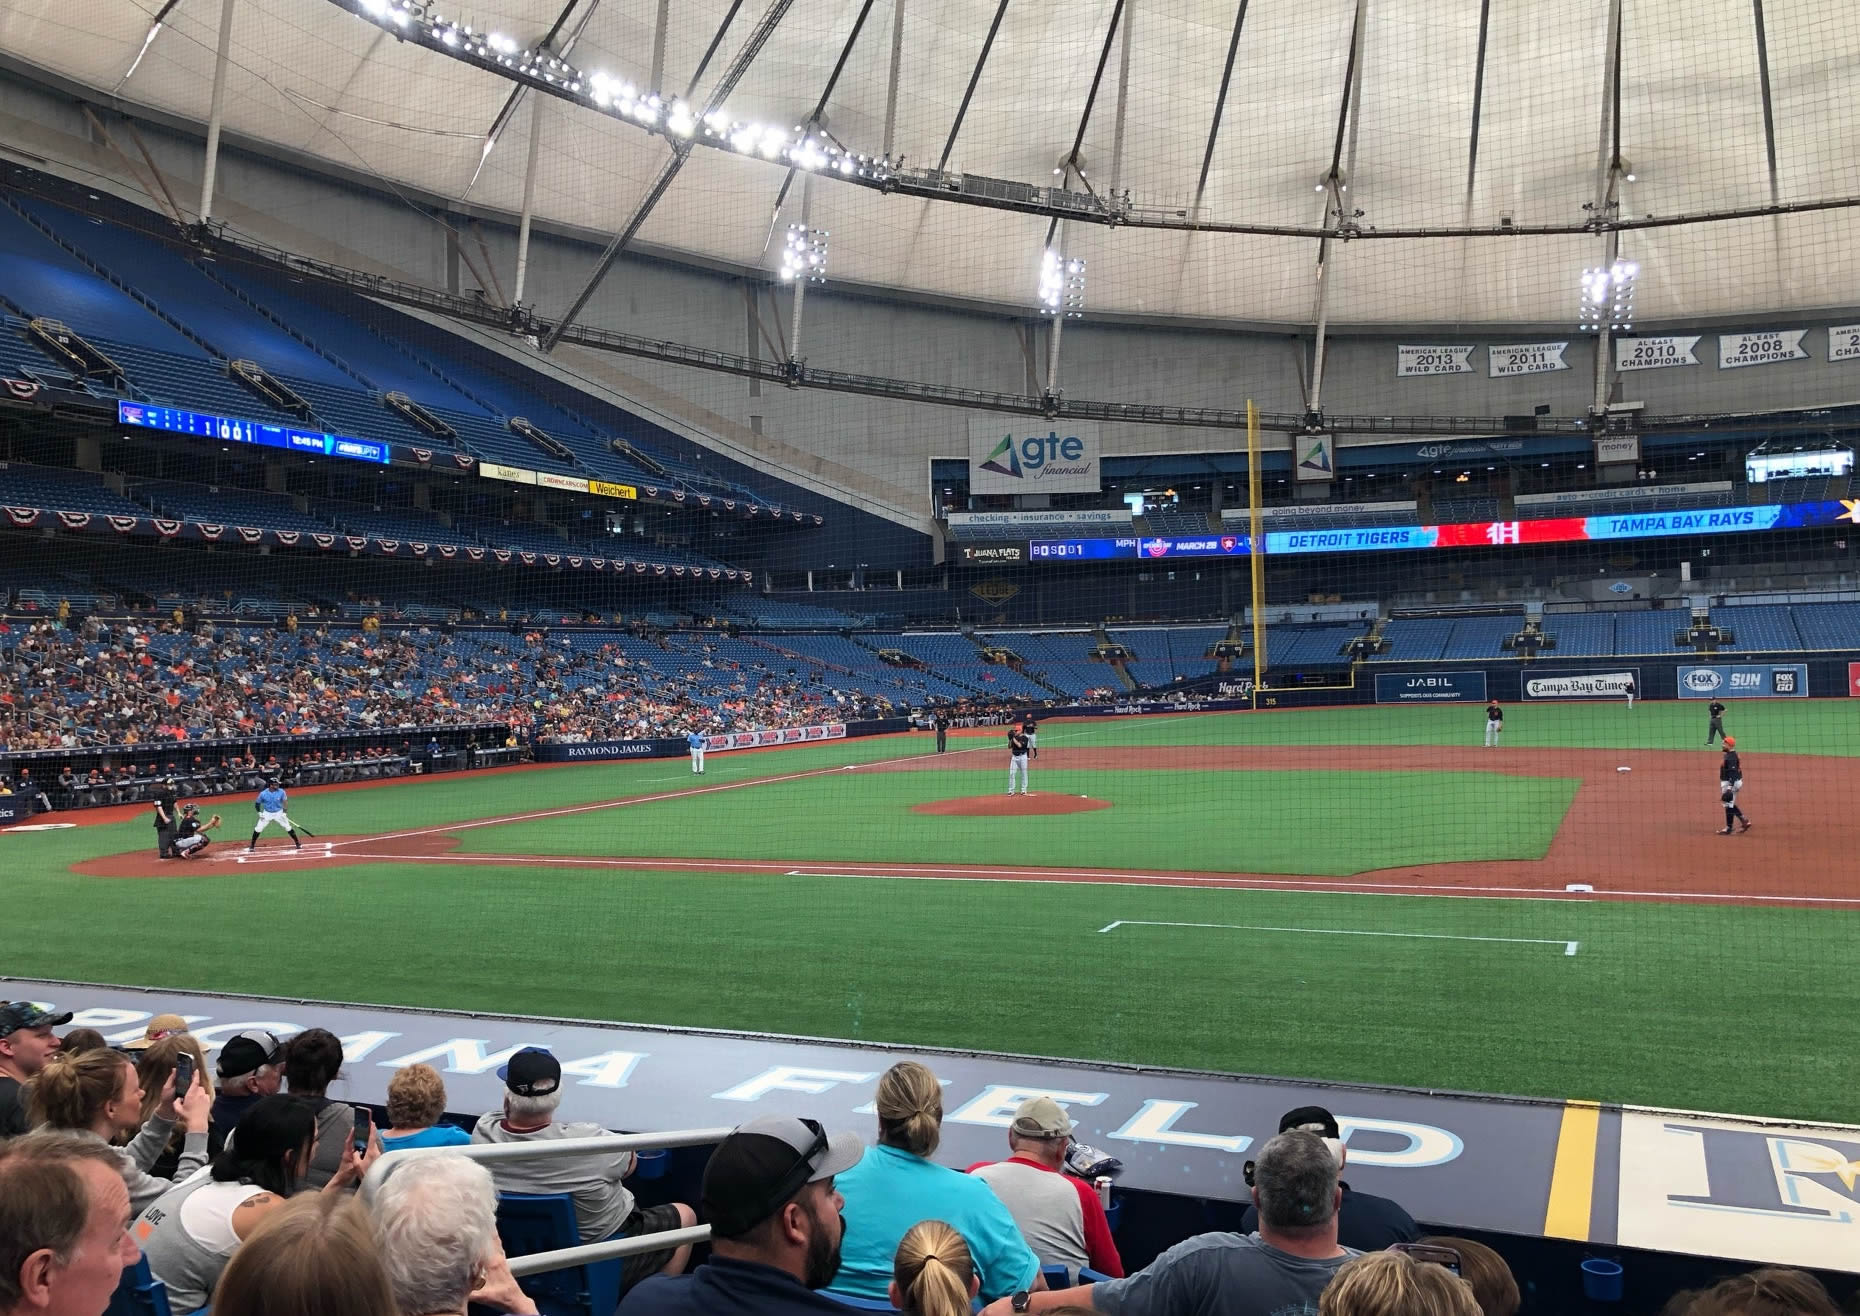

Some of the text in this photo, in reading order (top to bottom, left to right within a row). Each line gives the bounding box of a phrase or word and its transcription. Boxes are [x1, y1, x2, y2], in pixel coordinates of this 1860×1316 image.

[1652, 338, 1673, 346] EAST
[1738, 340, 1783, 355] 2008
[1492, 344, 1562, 355] AMERICAN LEAGUE
[1634, 346, 1676, 358] 2010
[1416, 354, 1453, 365] 2013
[1509, 353, 1545, 365] 2011
[1621, 357, 1688, 367] CHAMPIONS
[1726, 350, 1795, 364] CHAMPIONS
[1021, 431, 1084, 469] gte
[1601, 441, 1633, 452] money
[1034, 462, 1092, 479] financial
[595, 482, 631, 498] Weichert
[1588, 490, 1616, 499] credit
[1618, 488, 1646, 497] cards
[1658, 485, 1686, 494] home
[1271, 504, 1365, 516] going beyond money
[969, 512, 1112, 523] checking insurance savings
[1611, 511, 1754, 533] TAMPA BAY RAYS
[1115, 539, 1136, 547] MPH
[1289, 530, 1410, 547] DETROIT TIGERS
[1176, 541, 1205, 550] MARCH
[1407, 678, 1453, 687] JABIL
[1692, 674, 1713, 683] FOX
[1730, 673, 1761, 687] SUN
[1776, 673, 1793, 681] FOX
[1218, 681, 1244, 695] Hard
[1531, 679, 1629, 695] Tampa Bay Times
[1114, 705, 1142, 714] Hard Rock
[1174, 702, 1201, 711] Hard Rock
[568, 744, 652, 756] RAYMOND JAMES
[144, 1206, 166, 1226] LOVE
